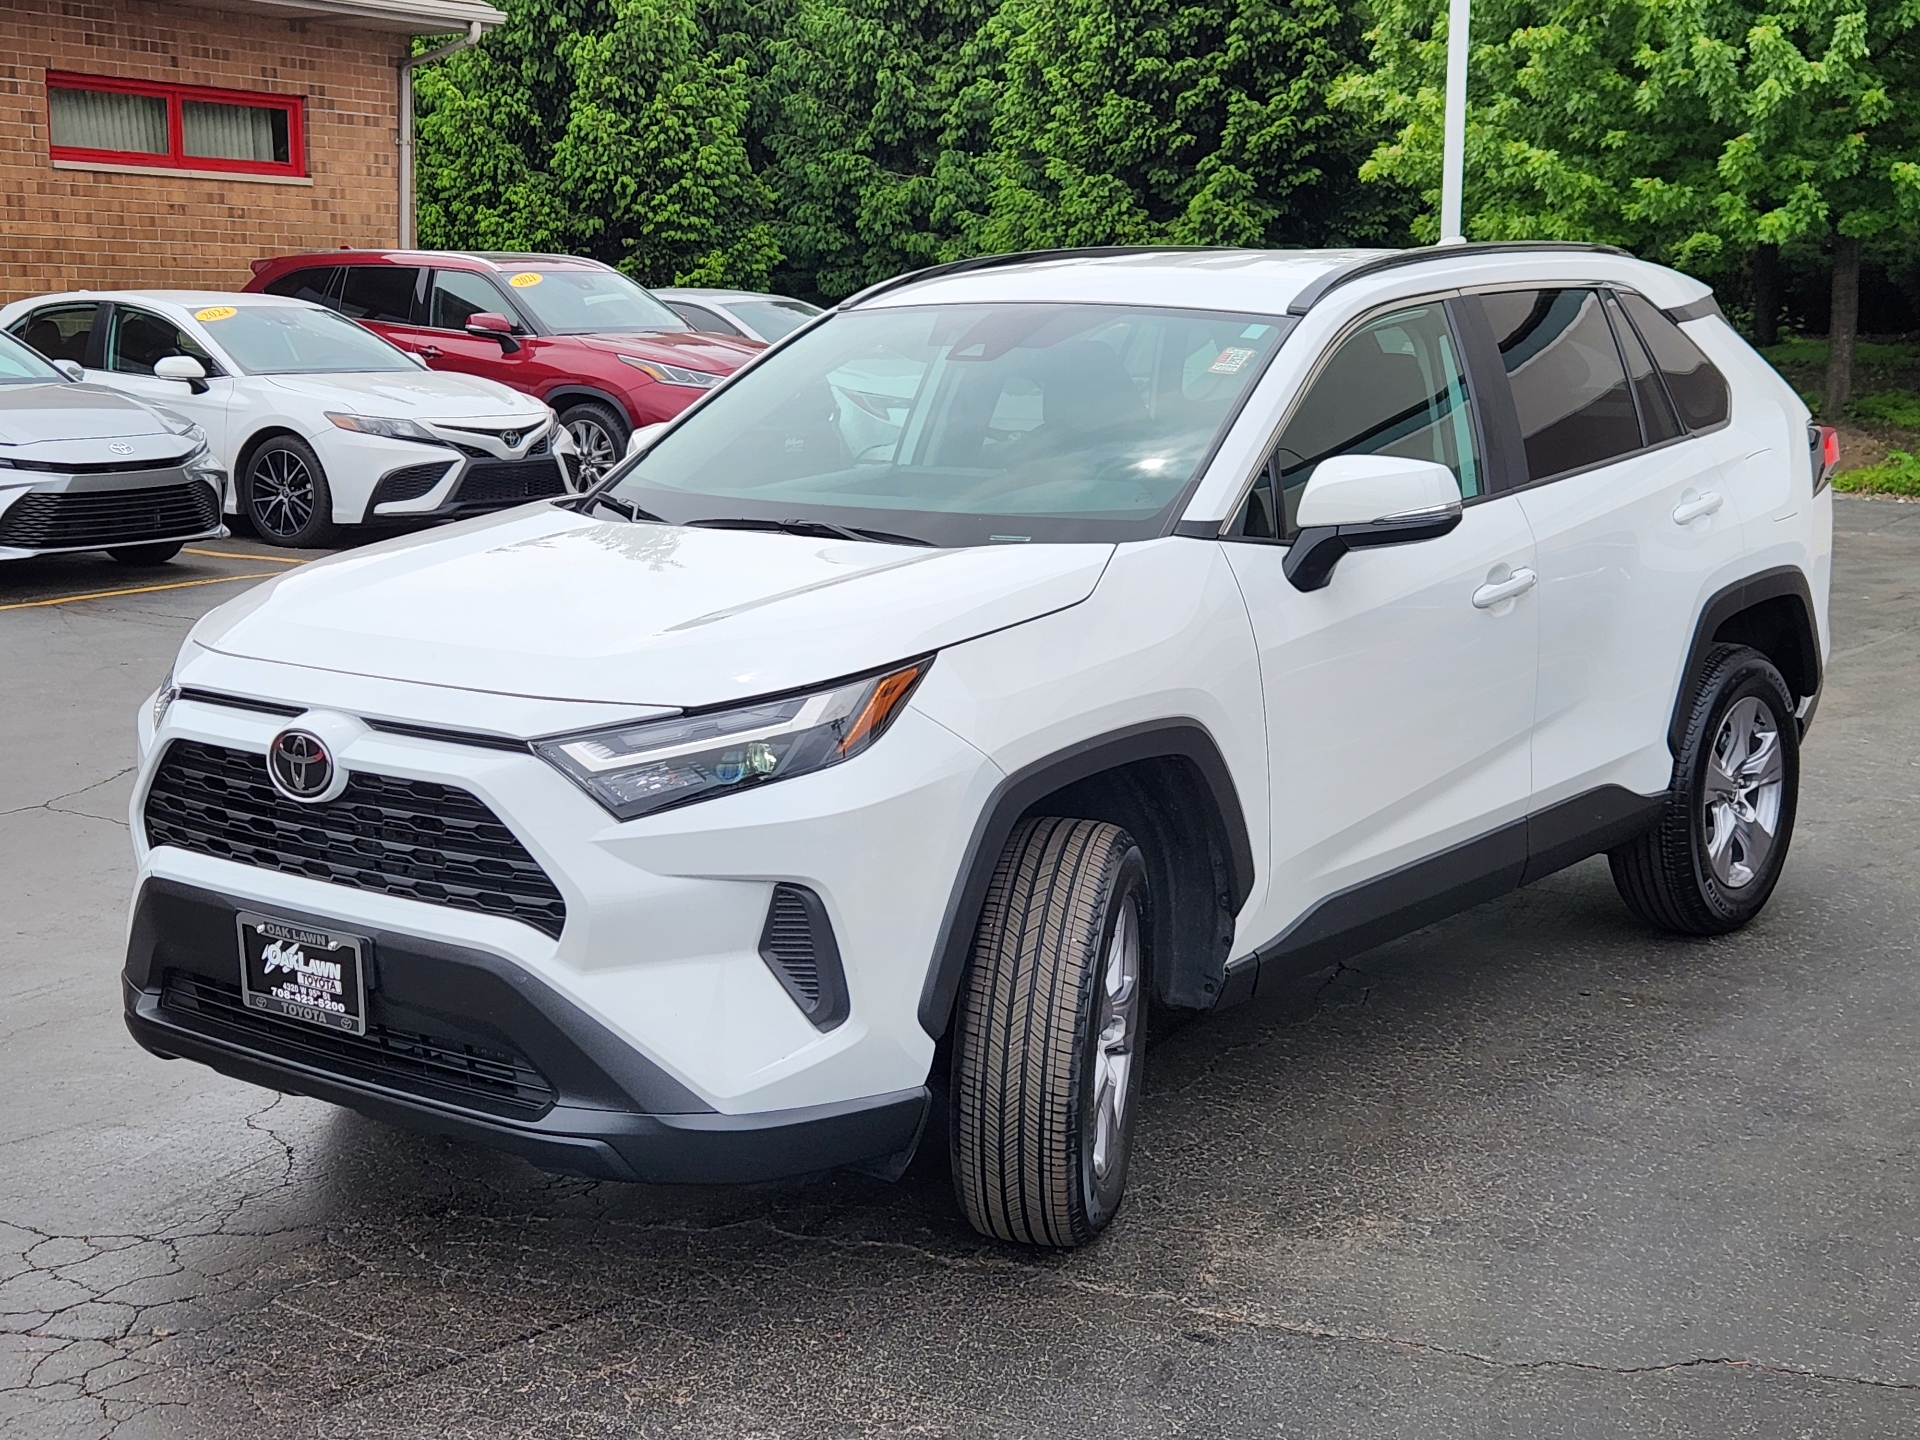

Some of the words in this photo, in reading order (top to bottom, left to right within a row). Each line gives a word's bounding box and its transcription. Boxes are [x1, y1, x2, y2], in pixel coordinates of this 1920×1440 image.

[515, 274, 537, 286] 2021
[202, 307, 230, 320] 2024
[266, 923, 291, 939] OAK
[292, 929, 327, 946] LAWN
[282, 981, 299, 993] 4320
[299, 986, 307, 996] W
[322, 991, 332, 1001] St
[301, 973, 337, 992] TOYOTA
[270, 986, 346, 1013] 708-423-5200
[280, 1001, 328, 1025] TOYOTA
